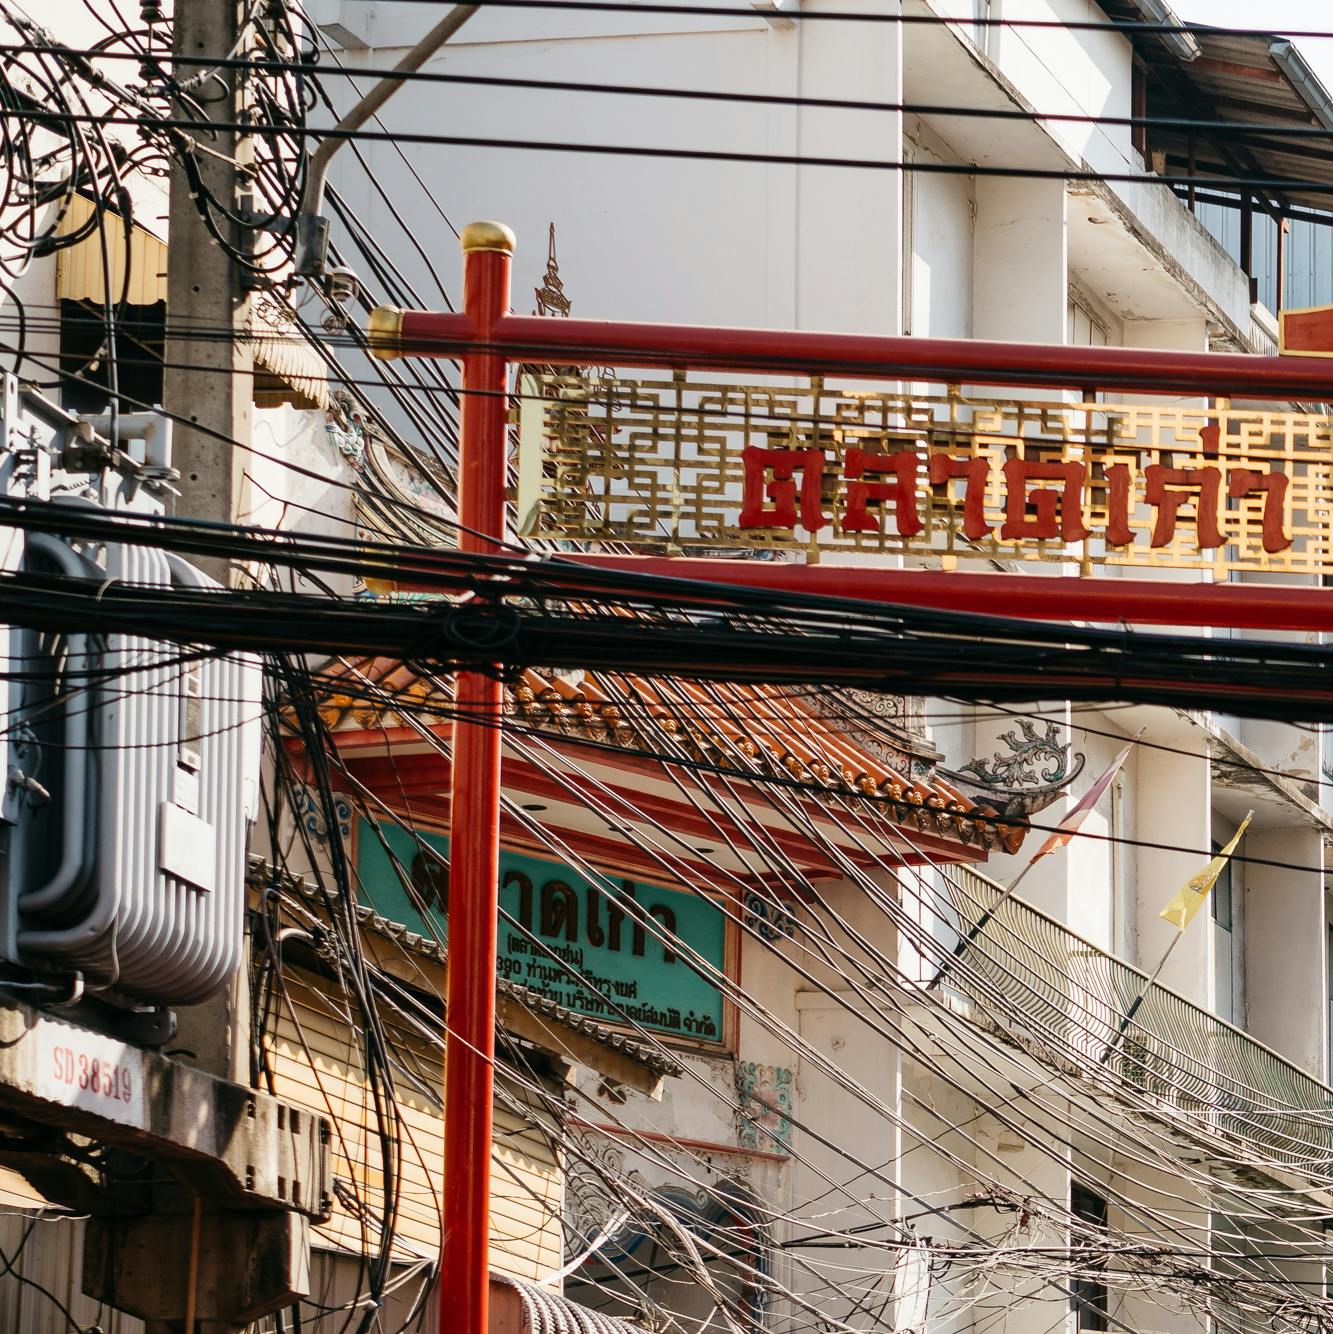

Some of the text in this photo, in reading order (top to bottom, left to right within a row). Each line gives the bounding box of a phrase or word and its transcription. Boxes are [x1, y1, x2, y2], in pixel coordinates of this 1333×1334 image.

[738, 423, 1293, 554] ตลาดเก่า
[411, 851, 677, 964] ตาดเก่า
